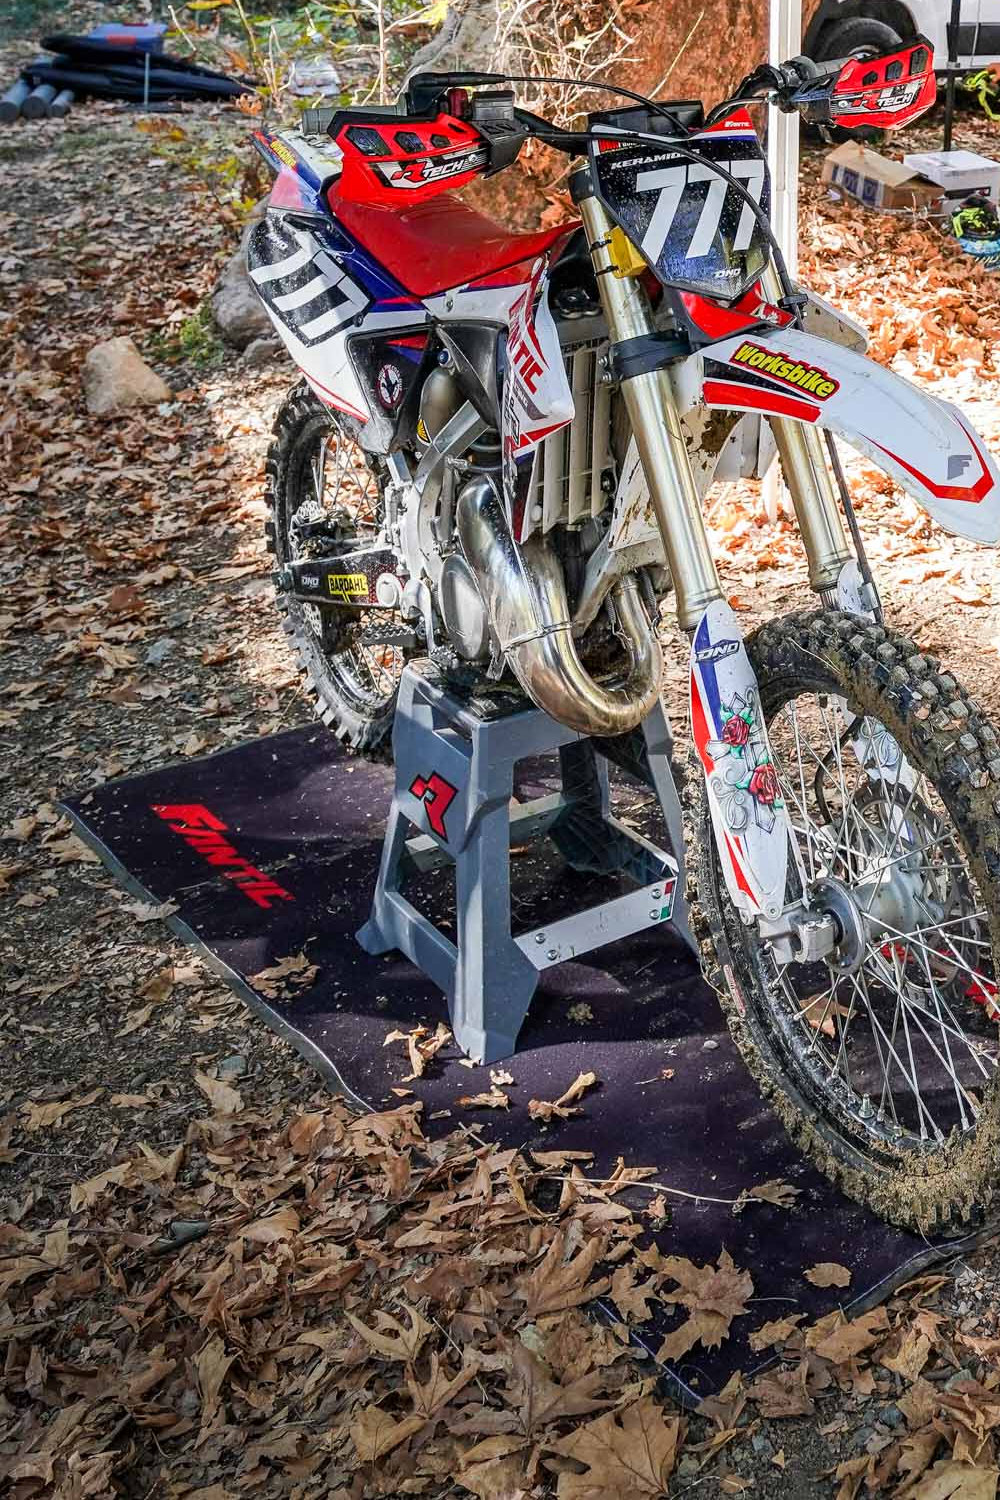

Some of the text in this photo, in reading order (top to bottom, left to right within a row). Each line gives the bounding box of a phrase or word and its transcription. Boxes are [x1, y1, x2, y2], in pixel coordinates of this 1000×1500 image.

[611, 149, 701, 170] KERAMID
[635, 159, 765, 266] 777
[248, 231, 371, 341] 777
[734, 343, 837, 398] Worksbike
[329, 577, 366, 592] BARDAHL
